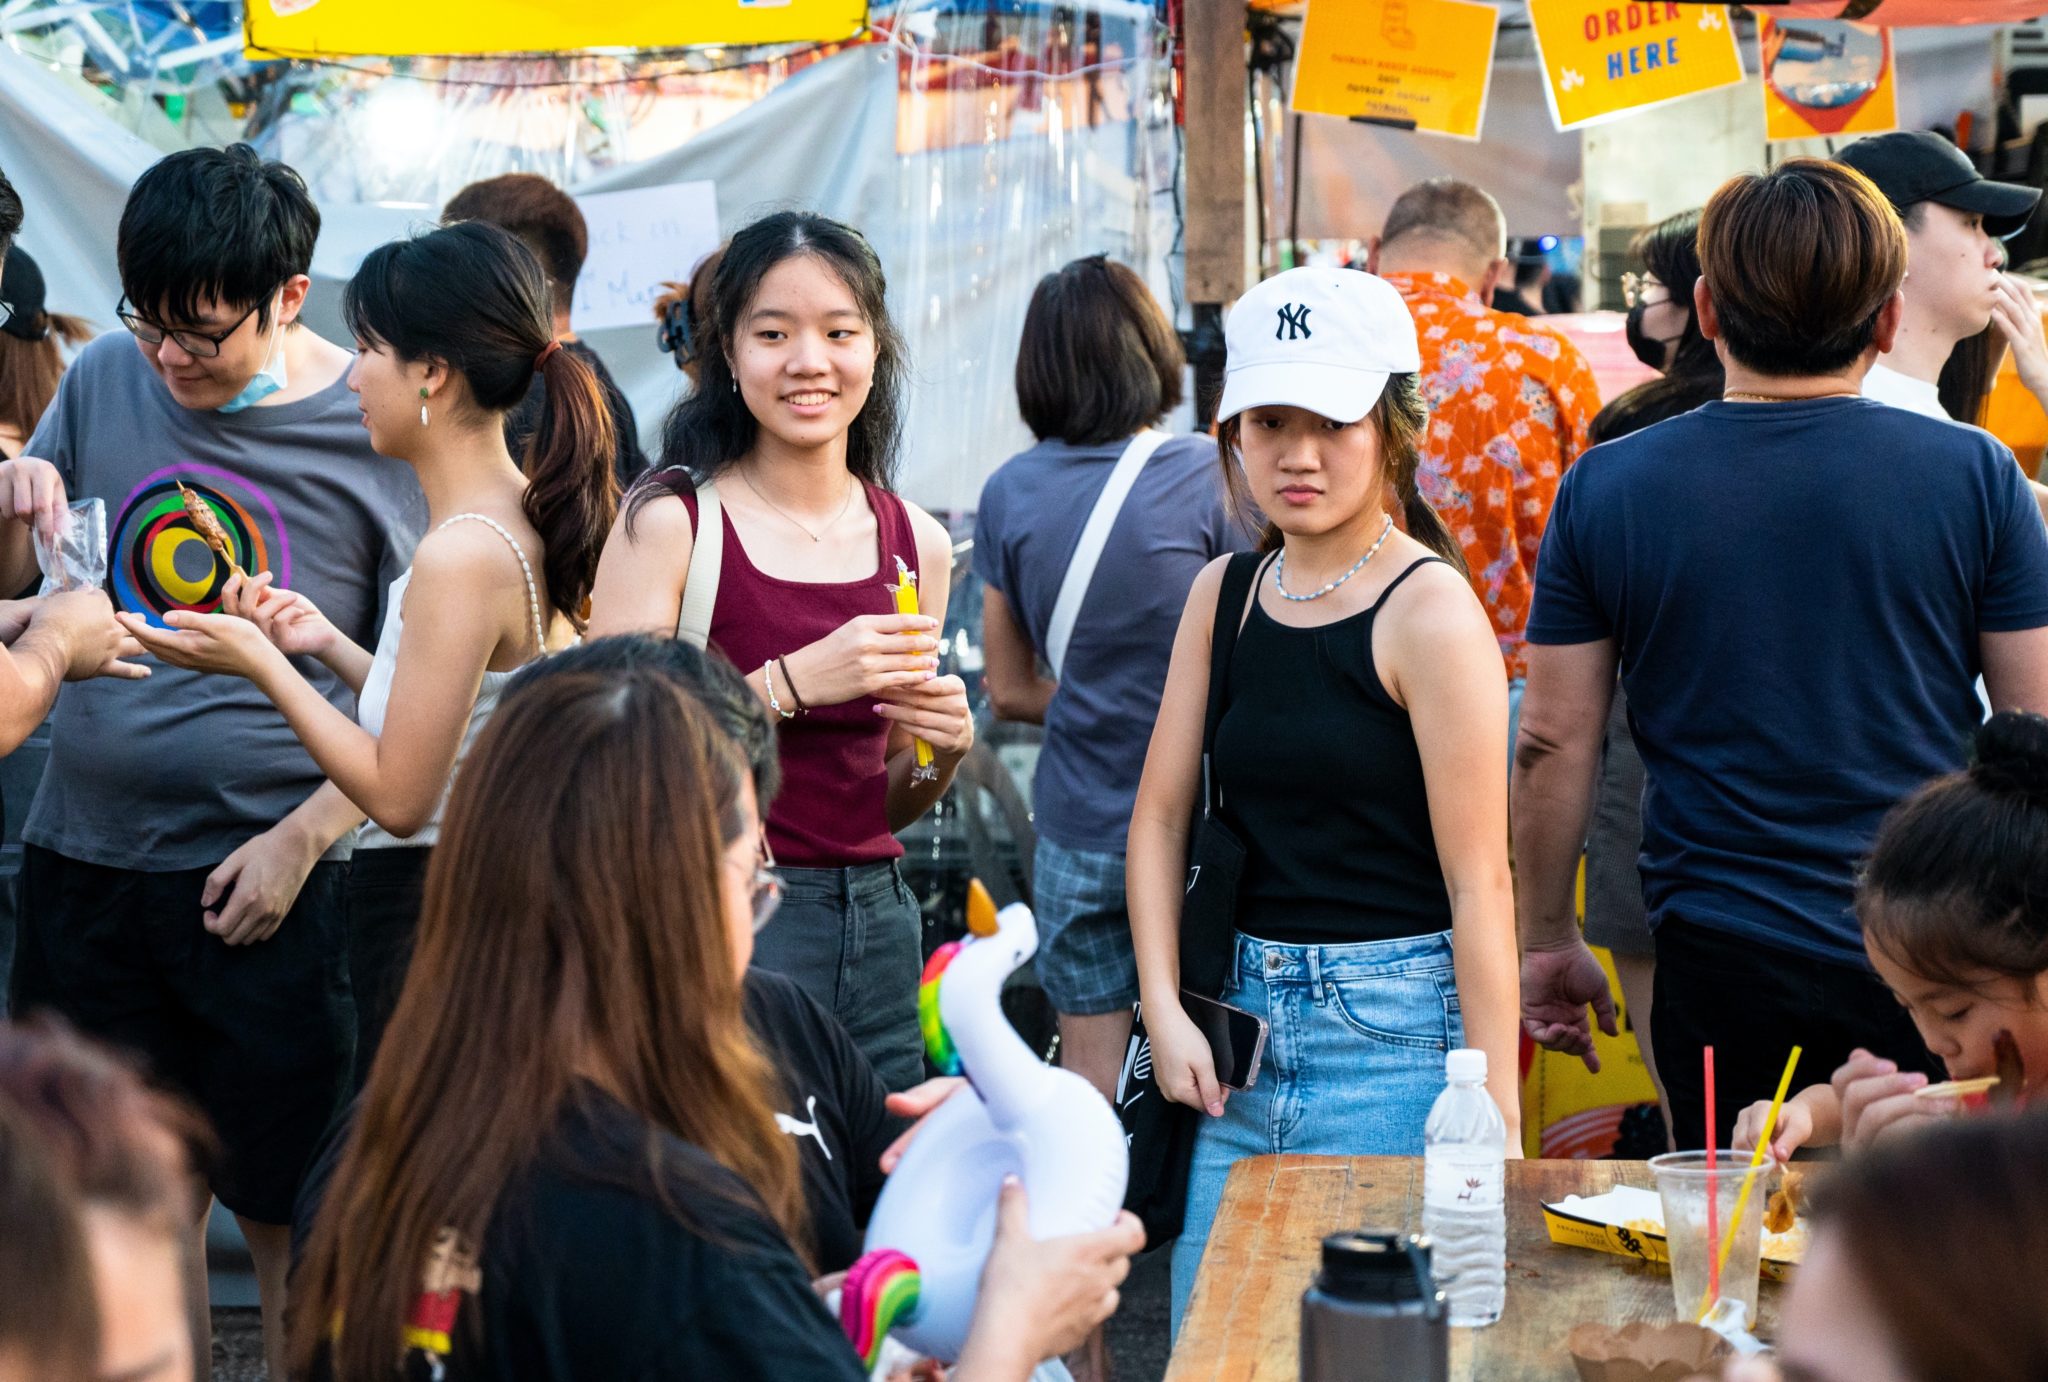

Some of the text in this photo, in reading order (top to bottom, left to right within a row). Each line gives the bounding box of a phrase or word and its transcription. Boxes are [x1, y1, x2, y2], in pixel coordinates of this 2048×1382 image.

[1584, 1, 1681, 42] ORDER
[1606, 37, 1680, 80] HERE
[1276, 302, 1312, 341] NY
